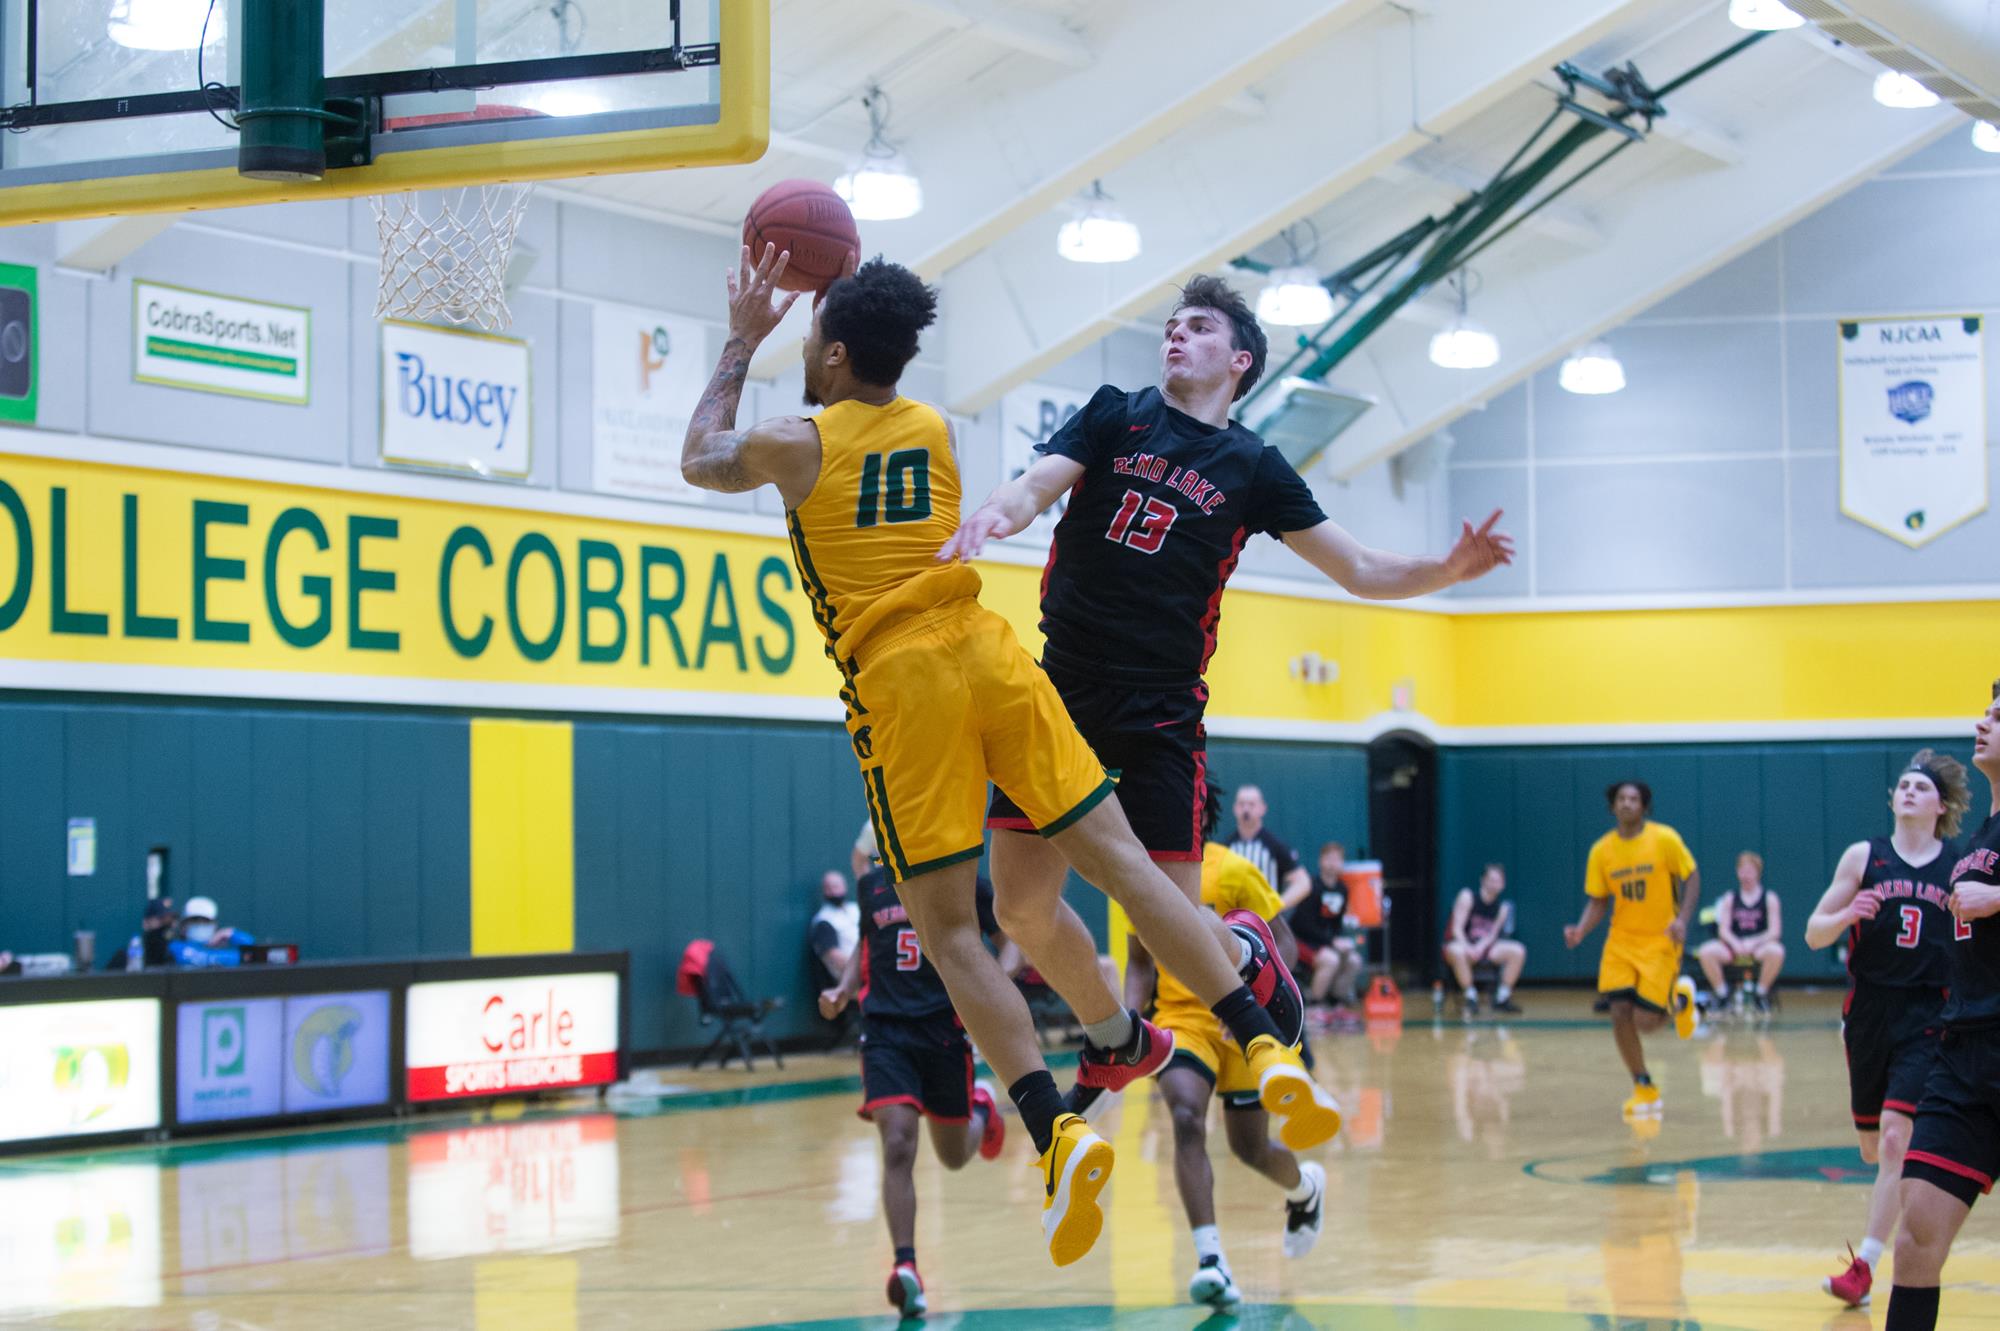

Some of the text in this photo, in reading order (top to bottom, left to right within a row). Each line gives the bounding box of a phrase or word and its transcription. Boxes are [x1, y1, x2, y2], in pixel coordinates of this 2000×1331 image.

[147, 300, 297, 347] CobraSports.Net
[1880, 326, 1942, 344] NJCAA
[395, 351, 517, 451] Busey
[855, 447, 933, 528] 10
[1165, 466, 1226, 516] LAKE
[1105, 488, 1179, 555] 13
[438, 524, 797, 676] COBRAS
[1620, 880, 1646, 902] 40
[896, 928, 921, 971] 5
[1896, 904, 1922, 949] 3
[481, 988, 574, 1053] Carle
[445, 1055, 583, 1094] SPORTS MEDICINE
